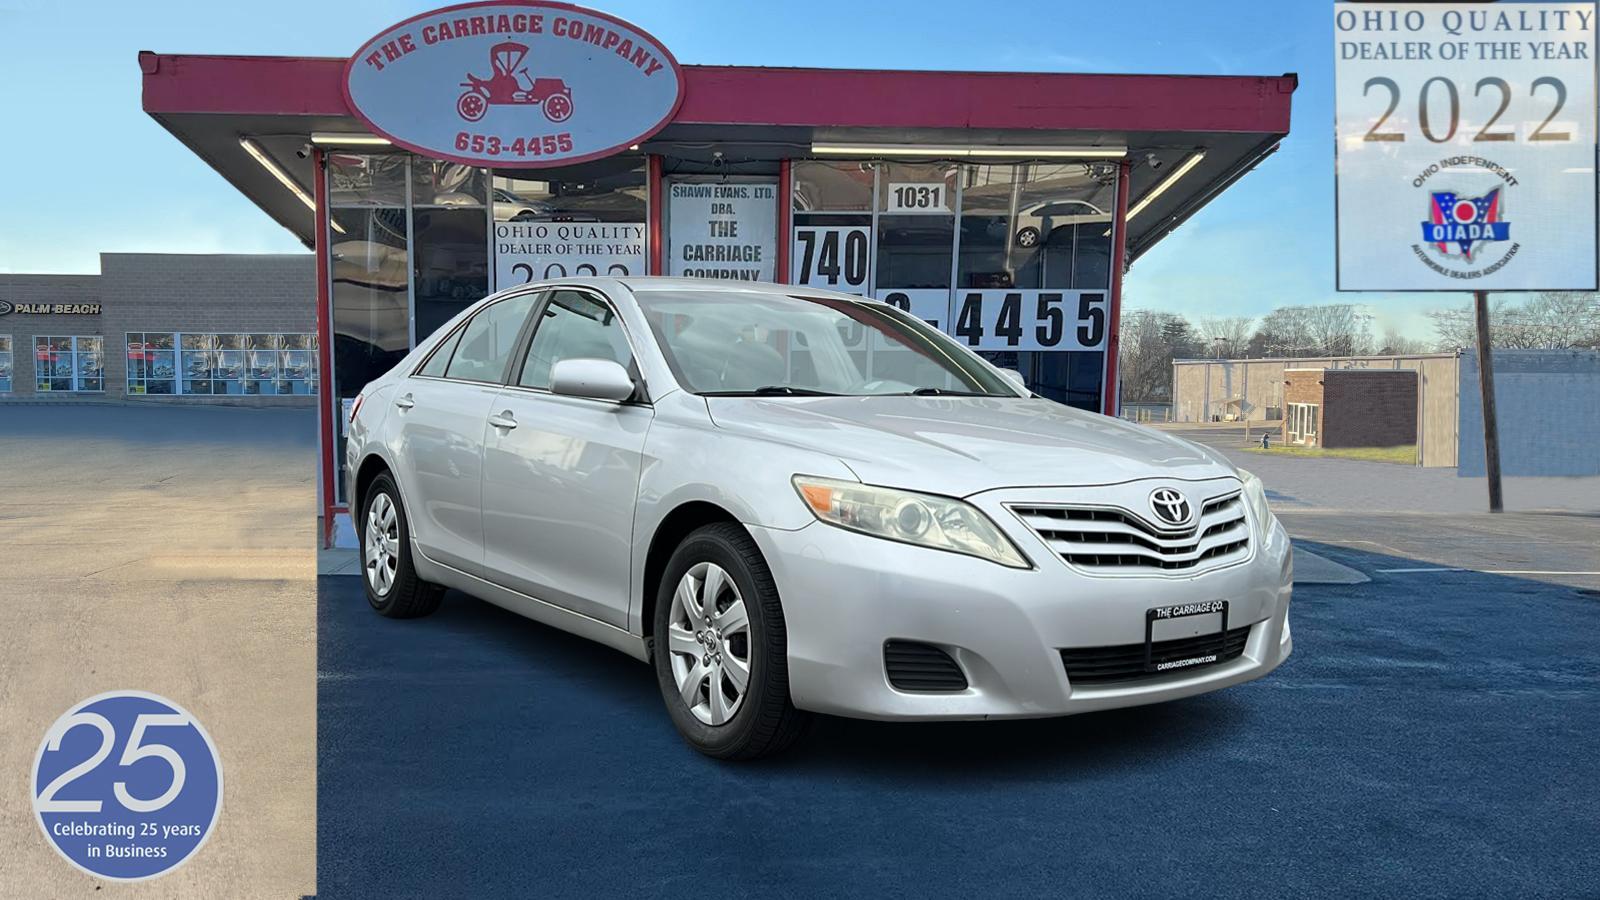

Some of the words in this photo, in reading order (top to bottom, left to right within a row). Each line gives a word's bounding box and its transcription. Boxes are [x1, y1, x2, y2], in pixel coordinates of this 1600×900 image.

[1336, 10, 1425, 31] OHIO
[1442, 10, 1592, 35] QUALITY
[365, 38, 417, 72] THE
[421, 14, 544, 46] CARRIAGE
[552, 17, 664, 77] COMPANY
[1340, 42, 1433, 60] DEALER
[1438, 42, 1470, 60] OF
[1474, 42, 1522, 60] THE
[1527, 42, 1589, 60] YEAR
[1362, 76, 1571, 143] 2022
[454, 132, 574, 157] 653-4455
[1412, 164, 1439, 188] OHIO
[1440, 156, 1519, 187] INDEPENDENT
[673, 186, 712, 198] SHAWN
[754, 187, 774, 199] LTD.
[894, 186, 941, 208] 1031
[711, 203, 736, 215] DBA.
[497, 226, 548, 239] OHIO
[557, 226, 643, 241] QUALITY
[708, 221, 738, 238] THE
[1432, 224, 1495, 240] OIADA
[499, 244, 552, 255] DEALER
[555, 244, 573, 255] OF
[576, 244, 603, 255] THE
[606, 244, 641, 255] YEAR
[683, 244, 762, 262] CARRIAGE
[797, 230, 868, 286] 740
[1449, 270, 1482, 280] DEALERS
[15, 303, 51, 314] PALM
[54, 304, 100, 314] BEACH
[1156, 608, 1172, 618] THE
[1173, 603, 1211, 616] CARRIAGE
[1157, 655, 1217, 670] CARRIAGECOMPANY.COM
